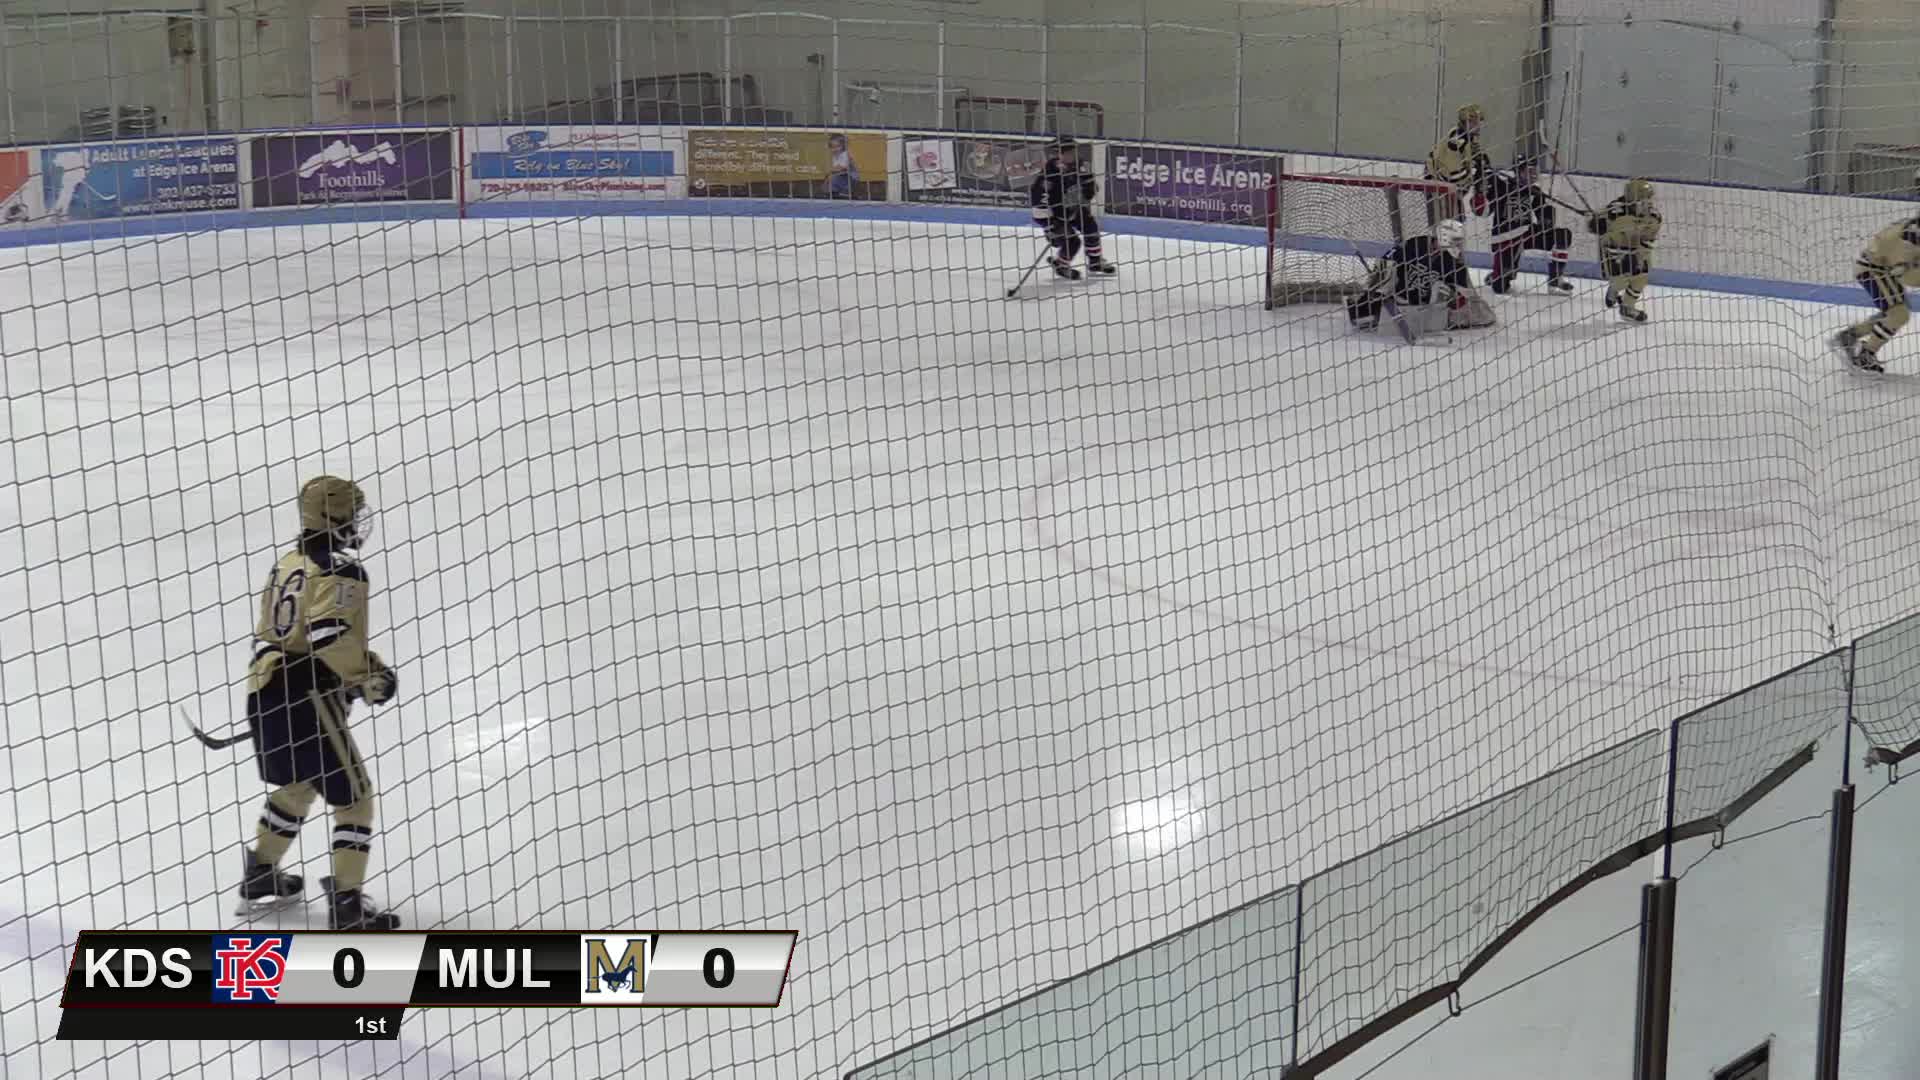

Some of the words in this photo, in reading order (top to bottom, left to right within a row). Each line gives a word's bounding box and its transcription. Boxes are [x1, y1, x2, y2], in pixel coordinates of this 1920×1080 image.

[92, 147, 129, 162] Adult
[133, 167, 147, 178] at
[149, 164, 178, 180] Edge
[200, 161, 236, 174] Arena
[317, 170, 385, 188] Foothills
[1115, 156, 1170, 188] Edge
[1174, 160, 1207, 185] Ice
[1210, 164, 1273, 190] Arena
